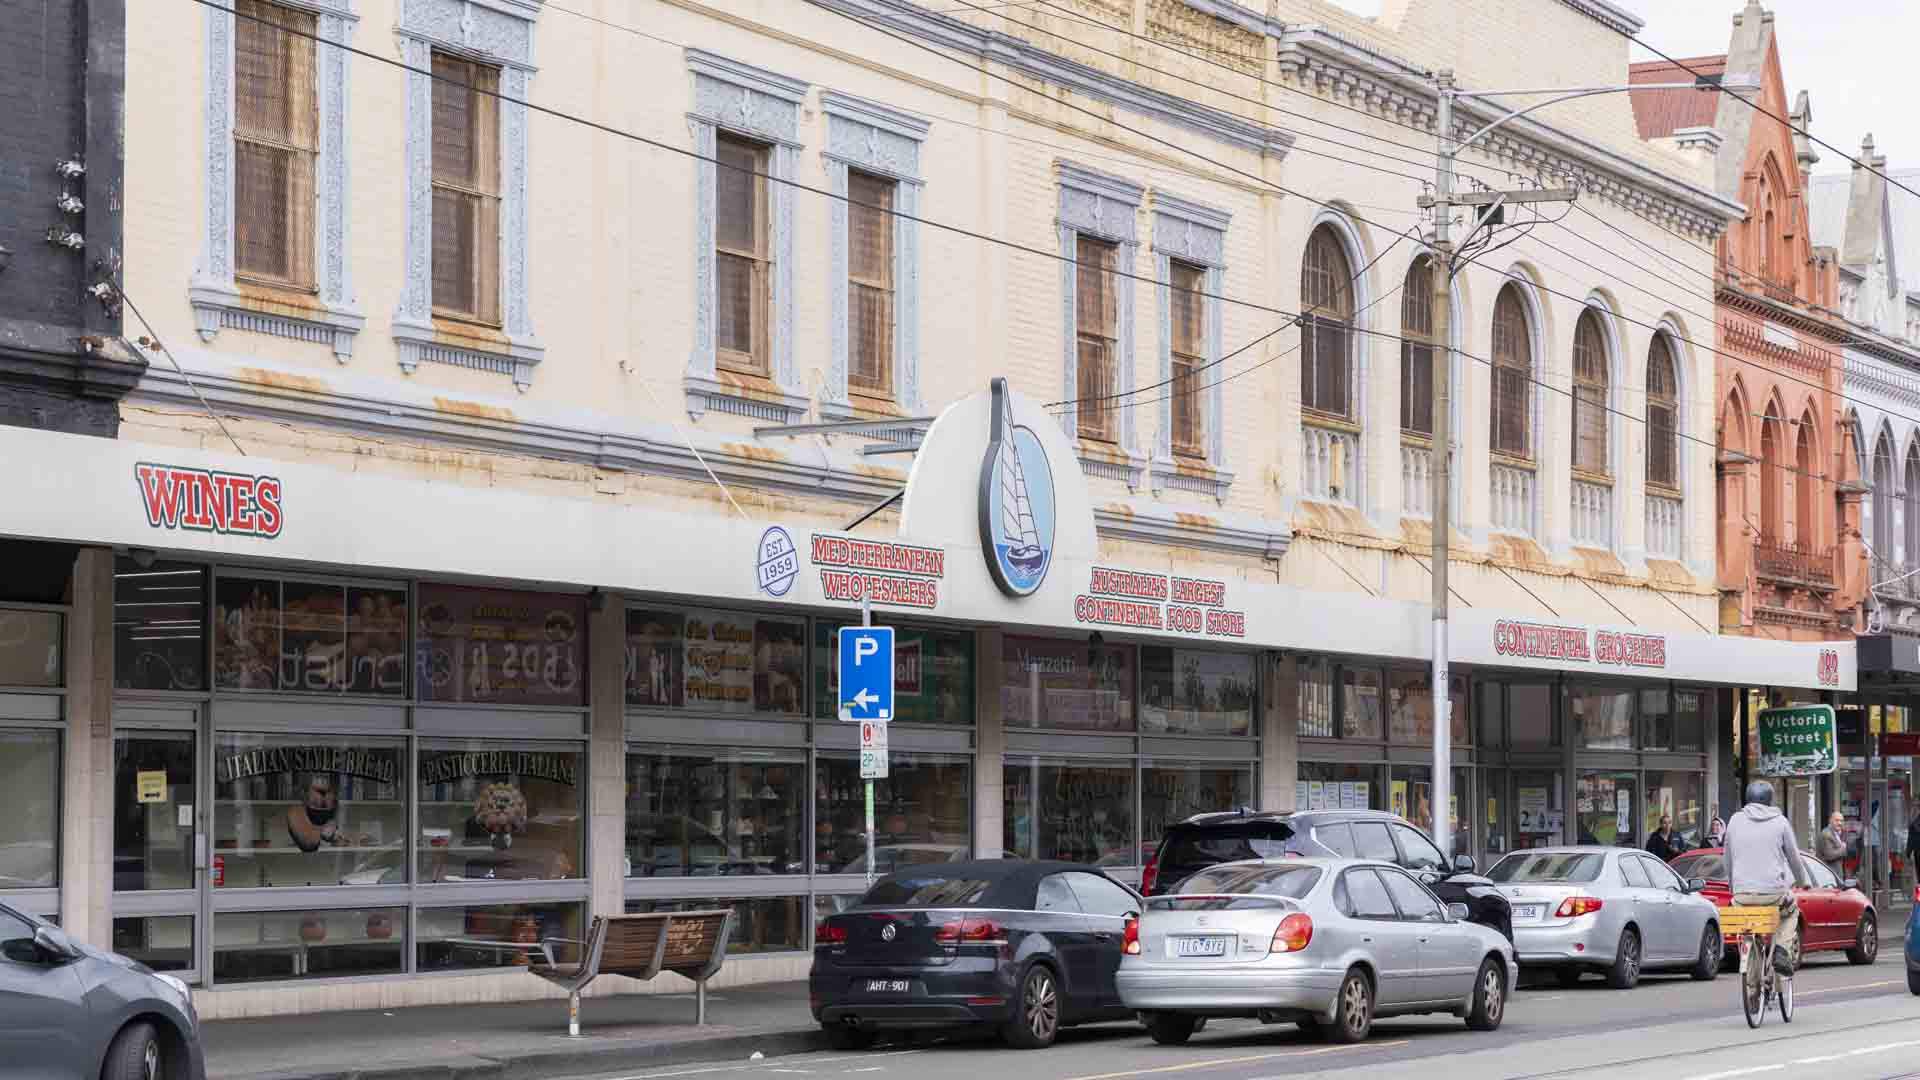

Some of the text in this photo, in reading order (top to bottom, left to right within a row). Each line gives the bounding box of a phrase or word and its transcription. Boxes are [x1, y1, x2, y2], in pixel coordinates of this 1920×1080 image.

[135, 462, 283, 539] WINES
[765, 538, 784, 558] EST
[811, 534, 945, 579] MEDITERRANEAN
[764, 557, 793, 581] 1959
[820, 569, 937, 609] WHOLESALERS
[1170, 577, 1225, 607] LARGEST
[1074, 594, 1245, 637] CONTINENTAL FOOD STORE
[855, 637, 879, 666] P
[1494, 619, 1665, 669] CONTINENTAL GROCERIES
[1766, 713, 1826, 728] Victoria
[1773, 731, 1821, 745] Street
[225, 747, 289, 781] ITALIAN
[345, 748, 394, 783] BREAD
[423, 750, 577, 786] PASTICCERIA ITALIANA
